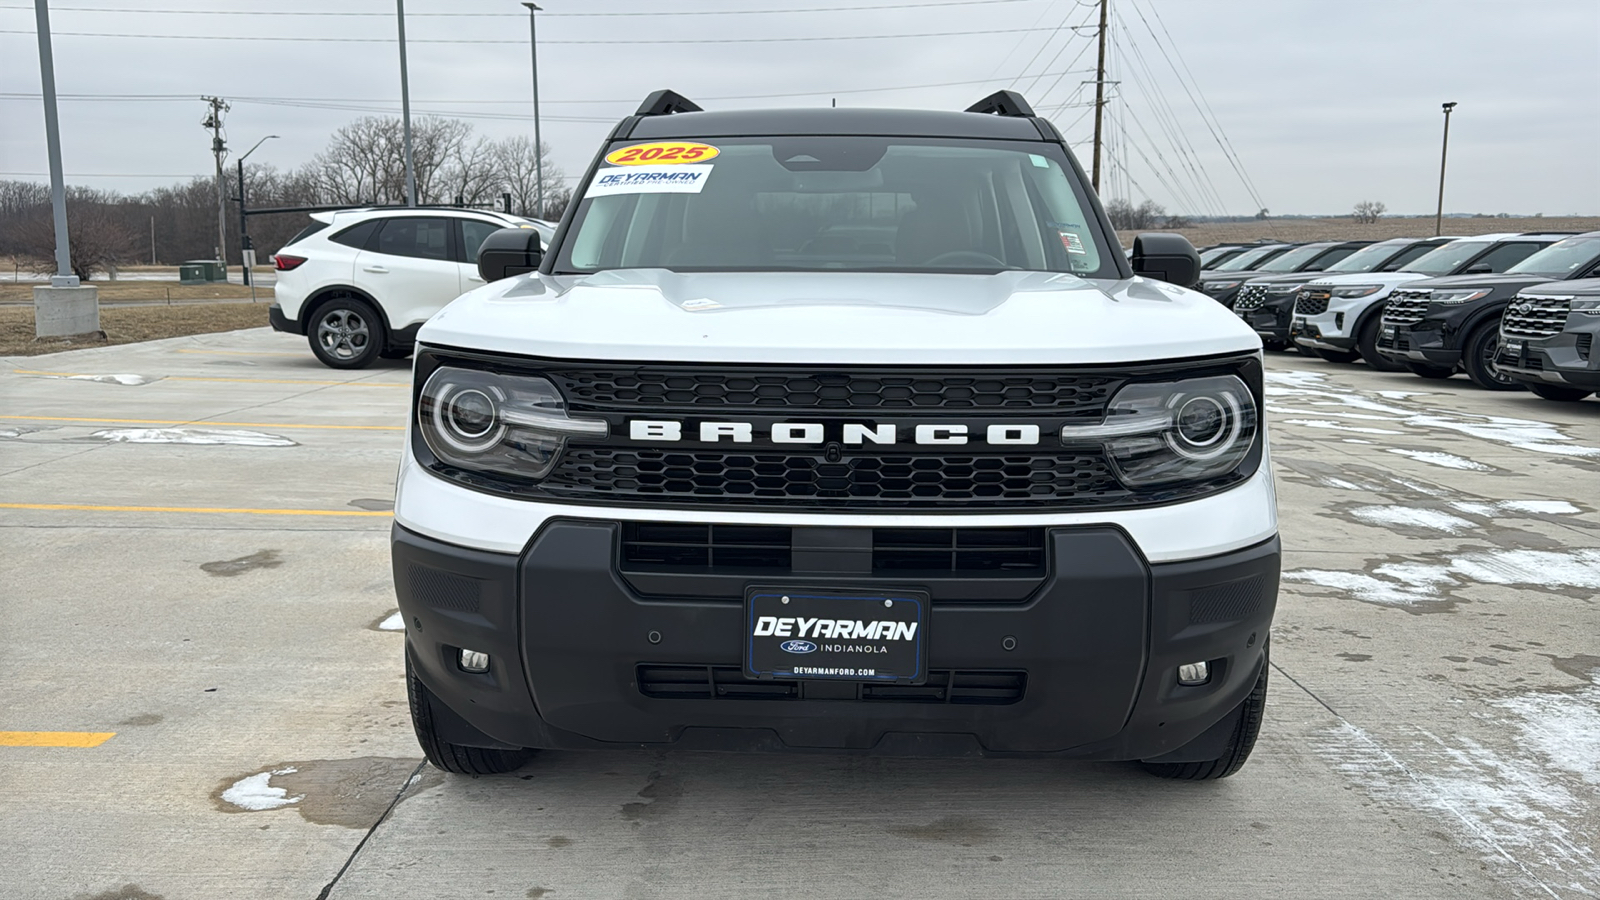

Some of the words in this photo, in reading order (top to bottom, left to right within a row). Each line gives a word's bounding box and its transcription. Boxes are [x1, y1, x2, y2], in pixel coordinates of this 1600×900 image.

[615, 147, 709, 162] 2025
[598, 172, 703, 184] DEYARMAN
[629, 420, 1040, 445] BRONCO
[753, 616, 918, 641] DEYARMAN
[785, 641, 812, 652] Ford
[820, 644, 888, 653] INDIANOLA
[793, 666, 875, 676] DEYARMANFORD.COM
